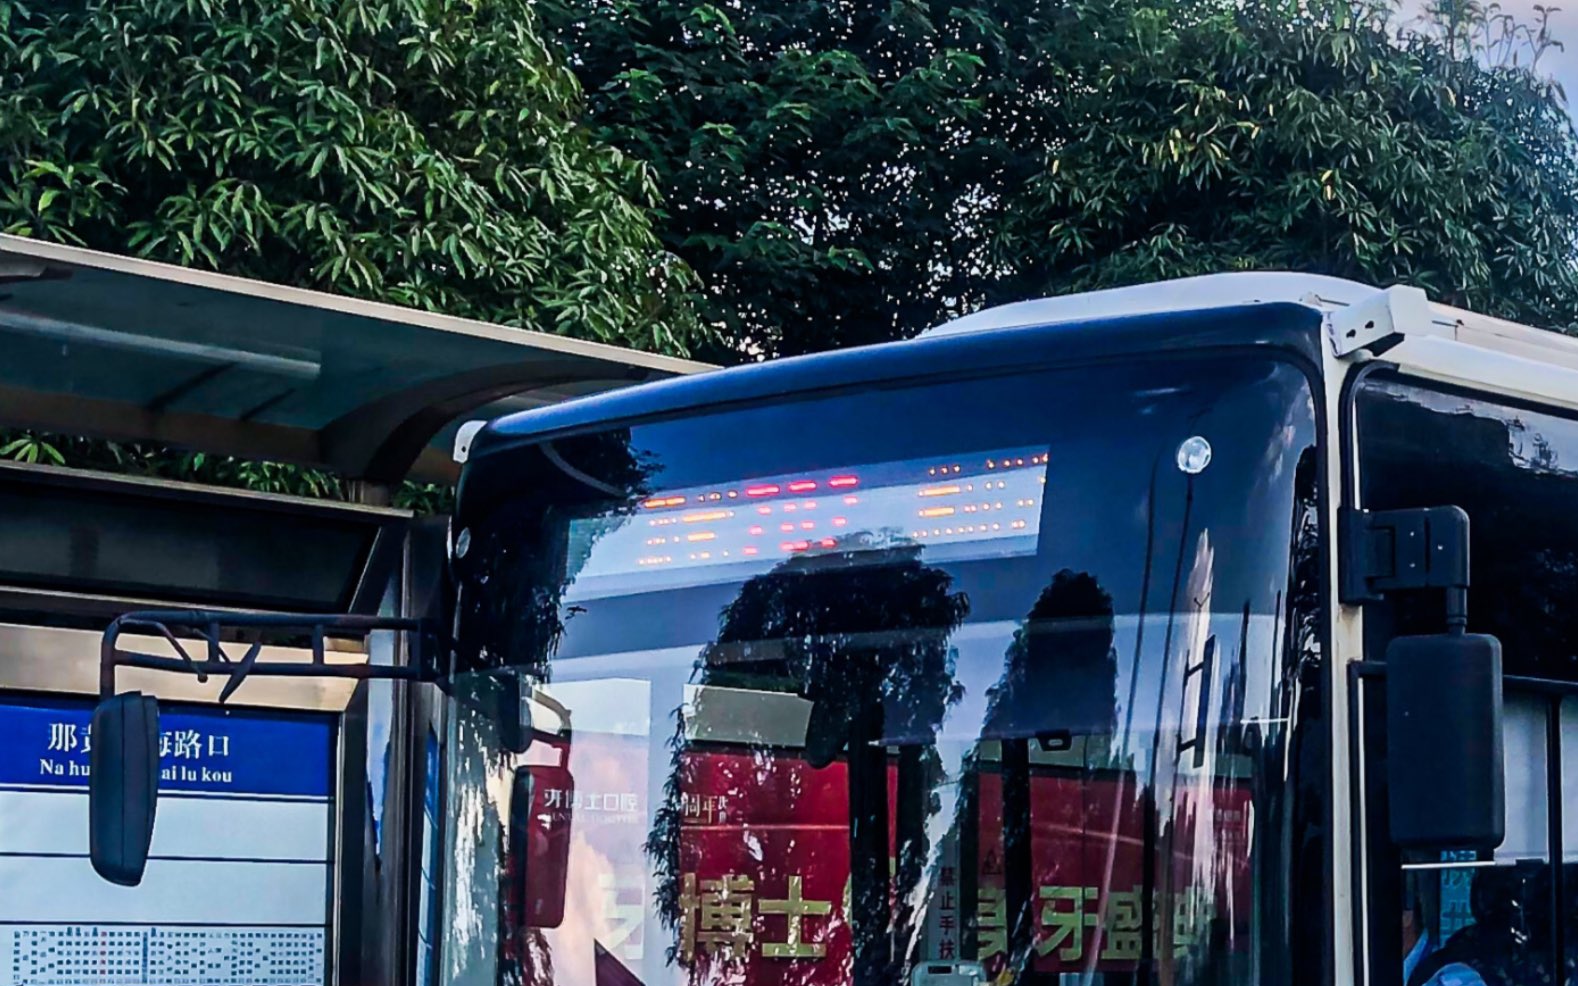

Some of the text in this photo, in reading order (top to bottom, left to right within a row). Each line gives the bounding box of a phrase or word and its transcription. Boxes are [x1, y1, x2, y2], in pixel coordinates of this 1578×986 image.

[39, 758, 64, 776] Na
[181, 766, 197, 781] lu
[201, 766, 232, 783] kou
